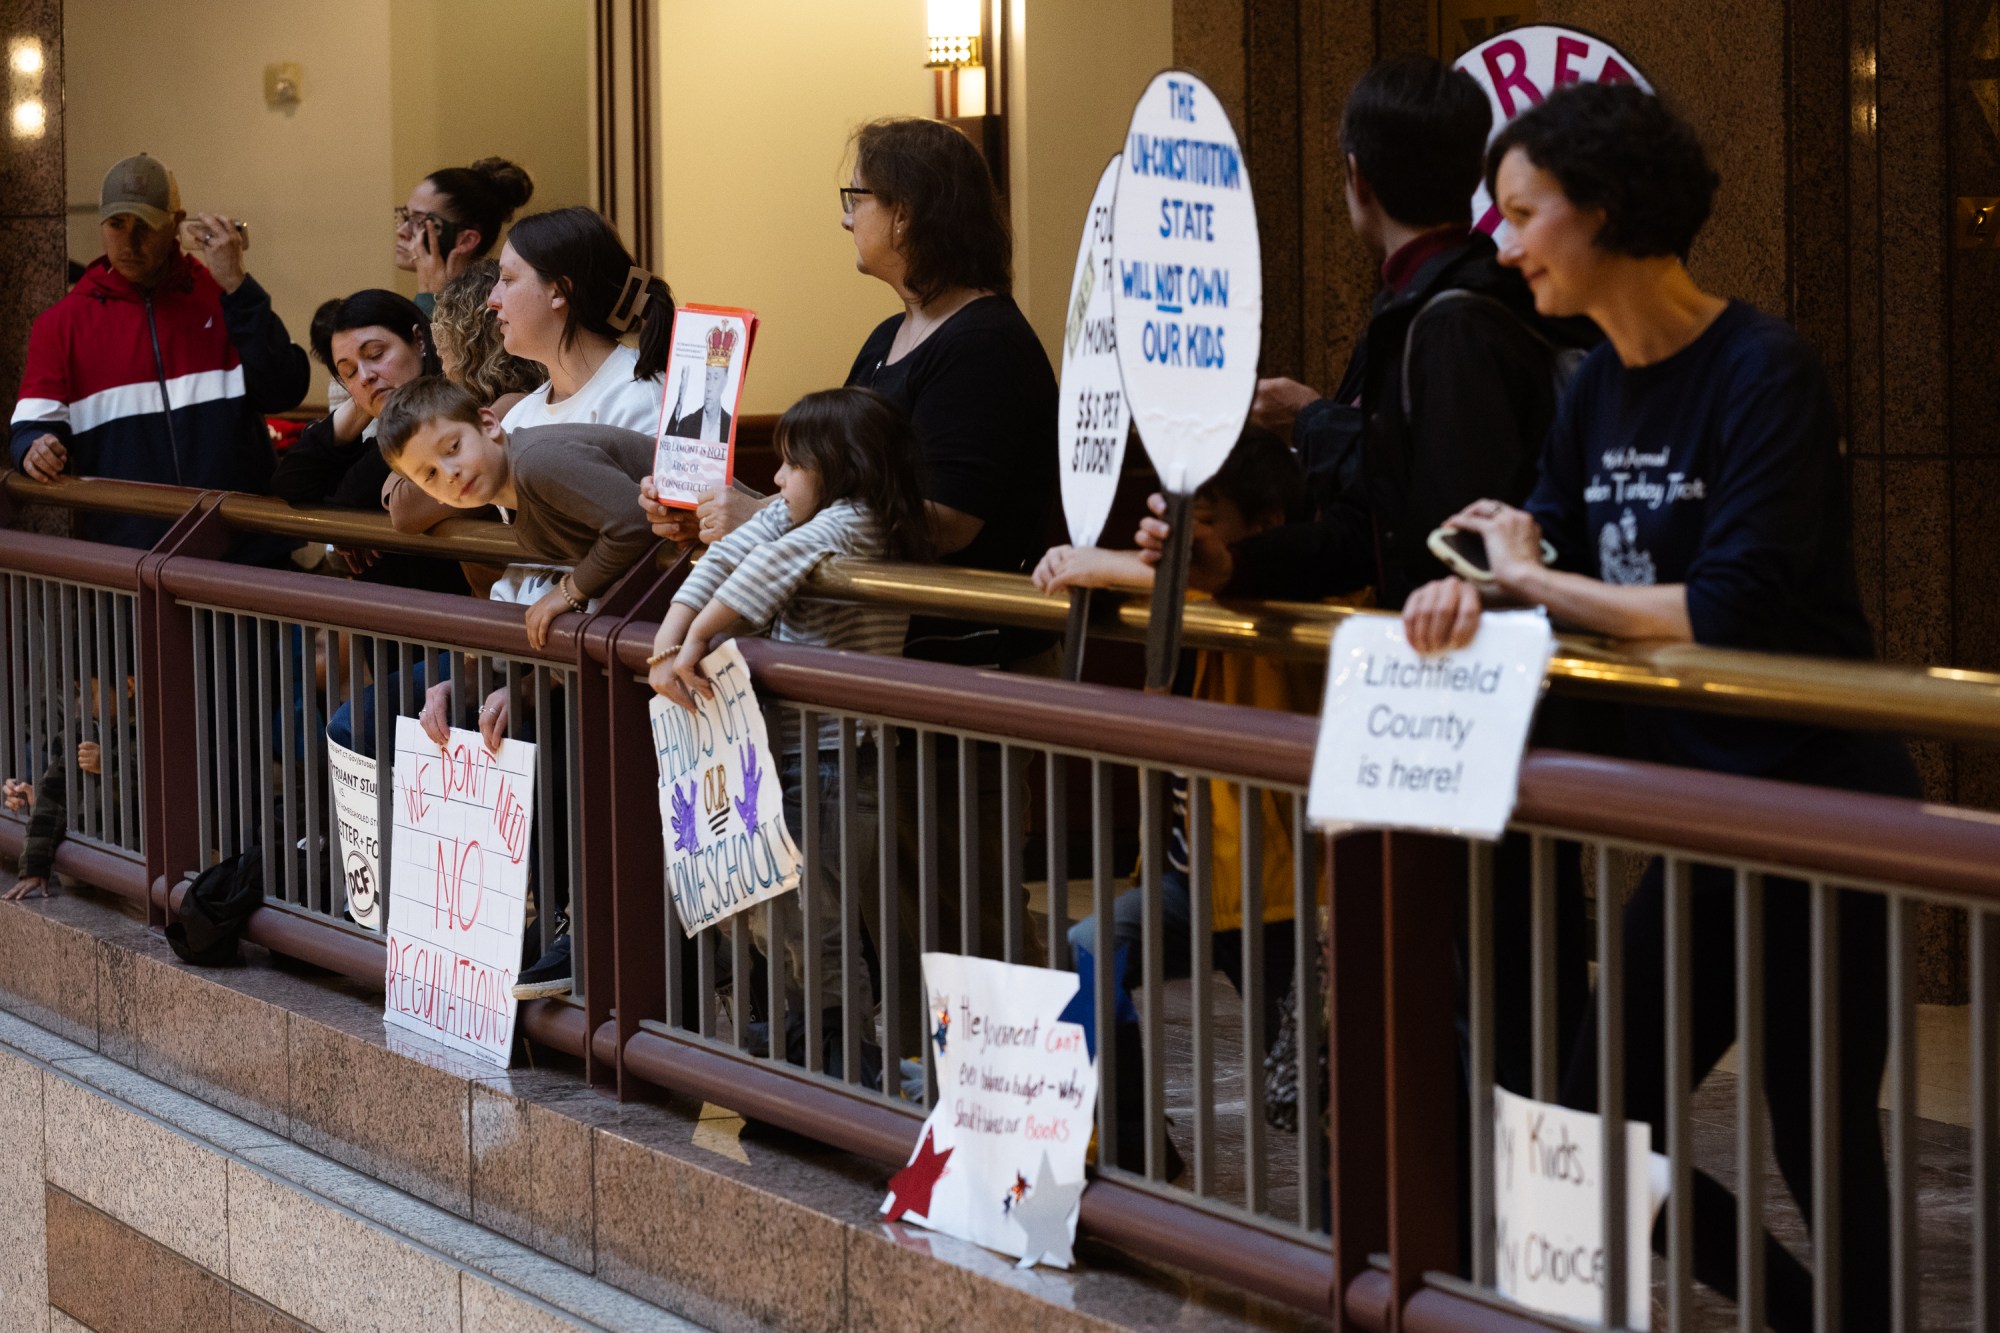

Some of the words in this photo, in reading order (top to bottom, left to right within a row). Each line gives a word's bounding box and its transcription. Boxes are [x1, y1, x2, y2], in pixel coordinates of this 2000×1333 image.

[1167, 80, 1196, 122] THE
[1159, 198, 1214, 242] STATE
[1120, 259, 1152, 300] WILL
[1155, 263, 1183, 305] NOT
[1188, 266, 1229, 308] OWN
[1083, 316, 1116, 357] MONE
[1142, 320, 1182, 366] OUR
[1186, 323, 1225, 369] KIDS
[671, 442, 699, 455] LAMONT
[707, 446, 727, 460] NOT
[671, 460, 689, 473] KING
[689, 463, 700, 474] OF
[1072, 437, 1117, 475] STUDENT
[661, 477, 710, 493] CONNECTICUT
[1363, 654, 1504, 694] Litchfield
[652, 687, 714, 788] HANDS
[707, 662, 746, 745] OFF
[1367, 703, 1475, 751] County
[704, 764, 730, 816] OUR
[1356, 753, 1382, 788] is
[1387, 755, 1464, 794] here!
[402, 753, 431, 825] WE
[493, 774, 526, 865] NEED
[338, 818, 360, 850] ETTER
[366, 836, 379, 860] FO
[348, 866, 369, 896] DCF
[434, 836, 484, 931] NO
[388, 936, 511, 1046] REGULATIONS
[960, 995, 980, 1041] The
[1024, 1113, 1070, 1142] Books
